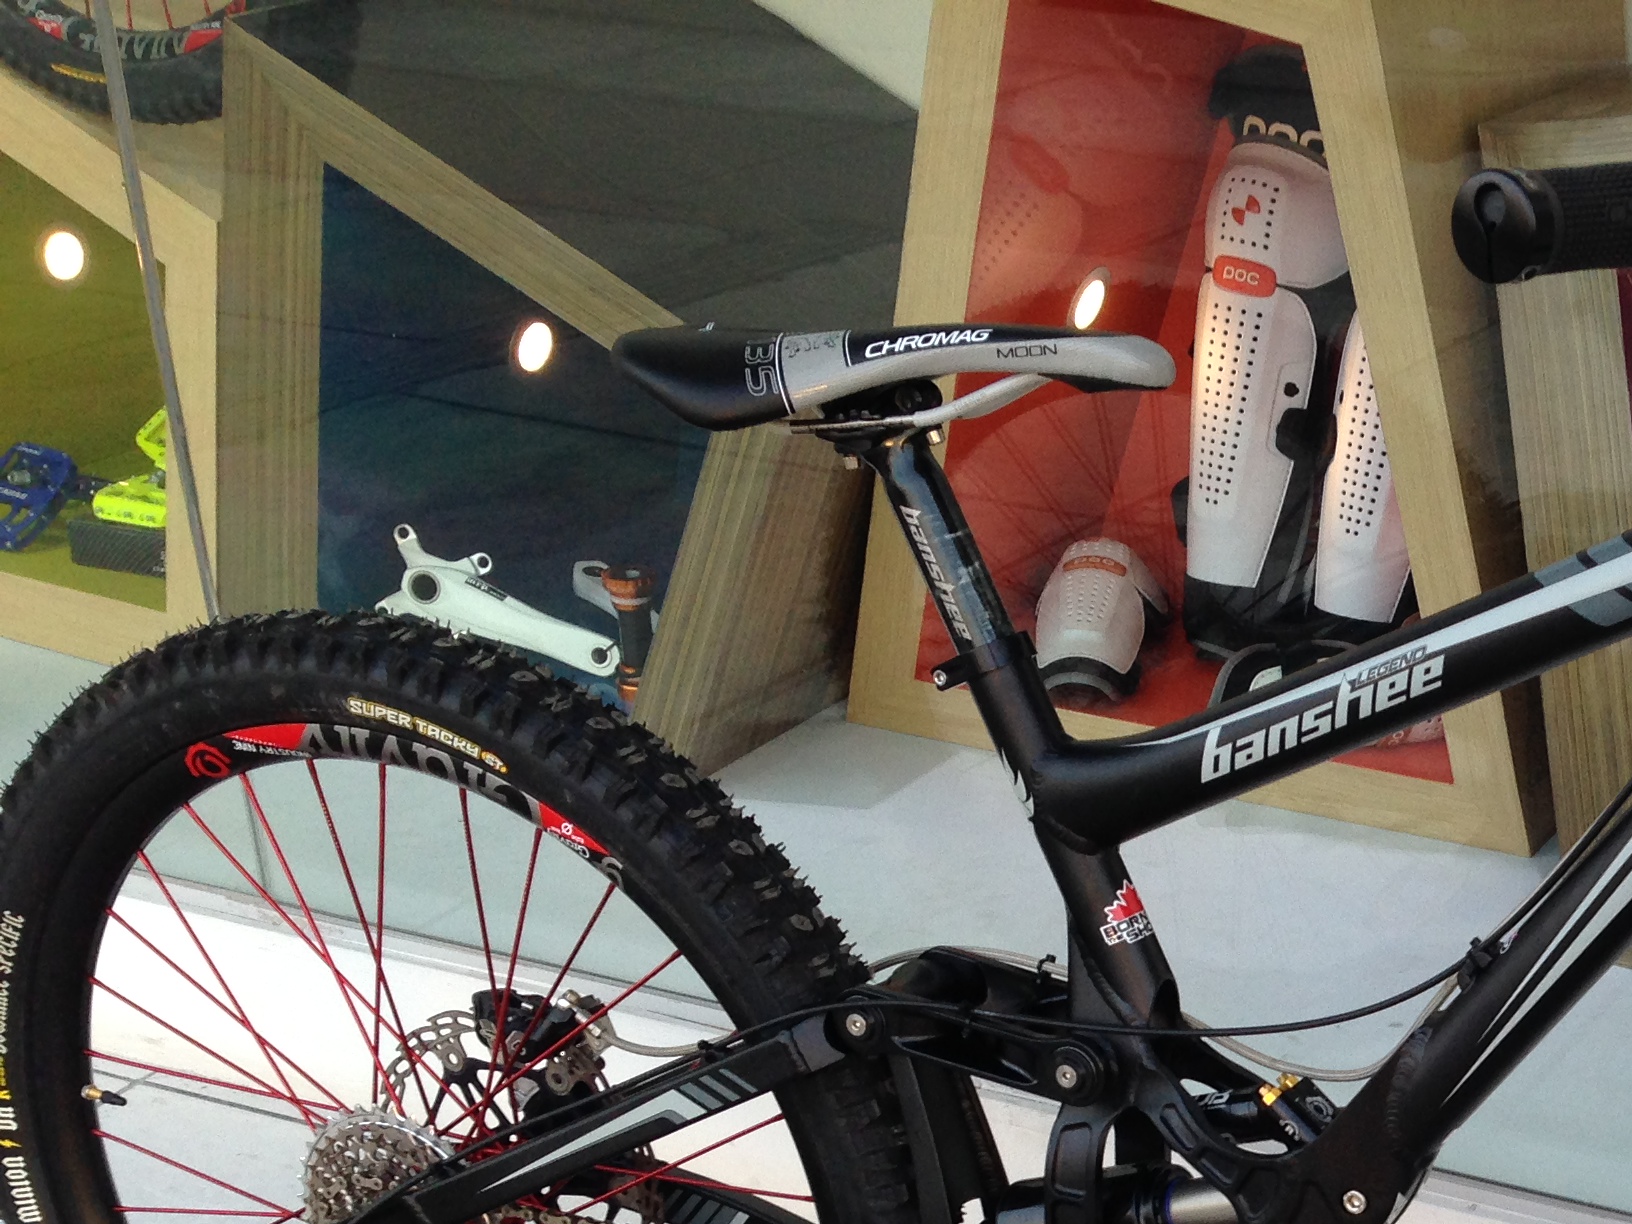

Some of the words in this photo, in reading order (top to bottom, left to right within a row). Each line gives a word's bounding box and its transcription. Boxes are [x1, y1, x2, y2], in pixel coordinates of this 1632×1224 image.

[863, 328, 994, 359] CHROMAG
[995, 343, 1058, 360] MOON
[899, 504, 973, 641] banshee
[1355, 643, 1429, 687] LEGEND
[347, 695, 413, 731] SUPER
[412, 717, 482, 760] TACKY
[1200, 653, 1446, 784] banshee
